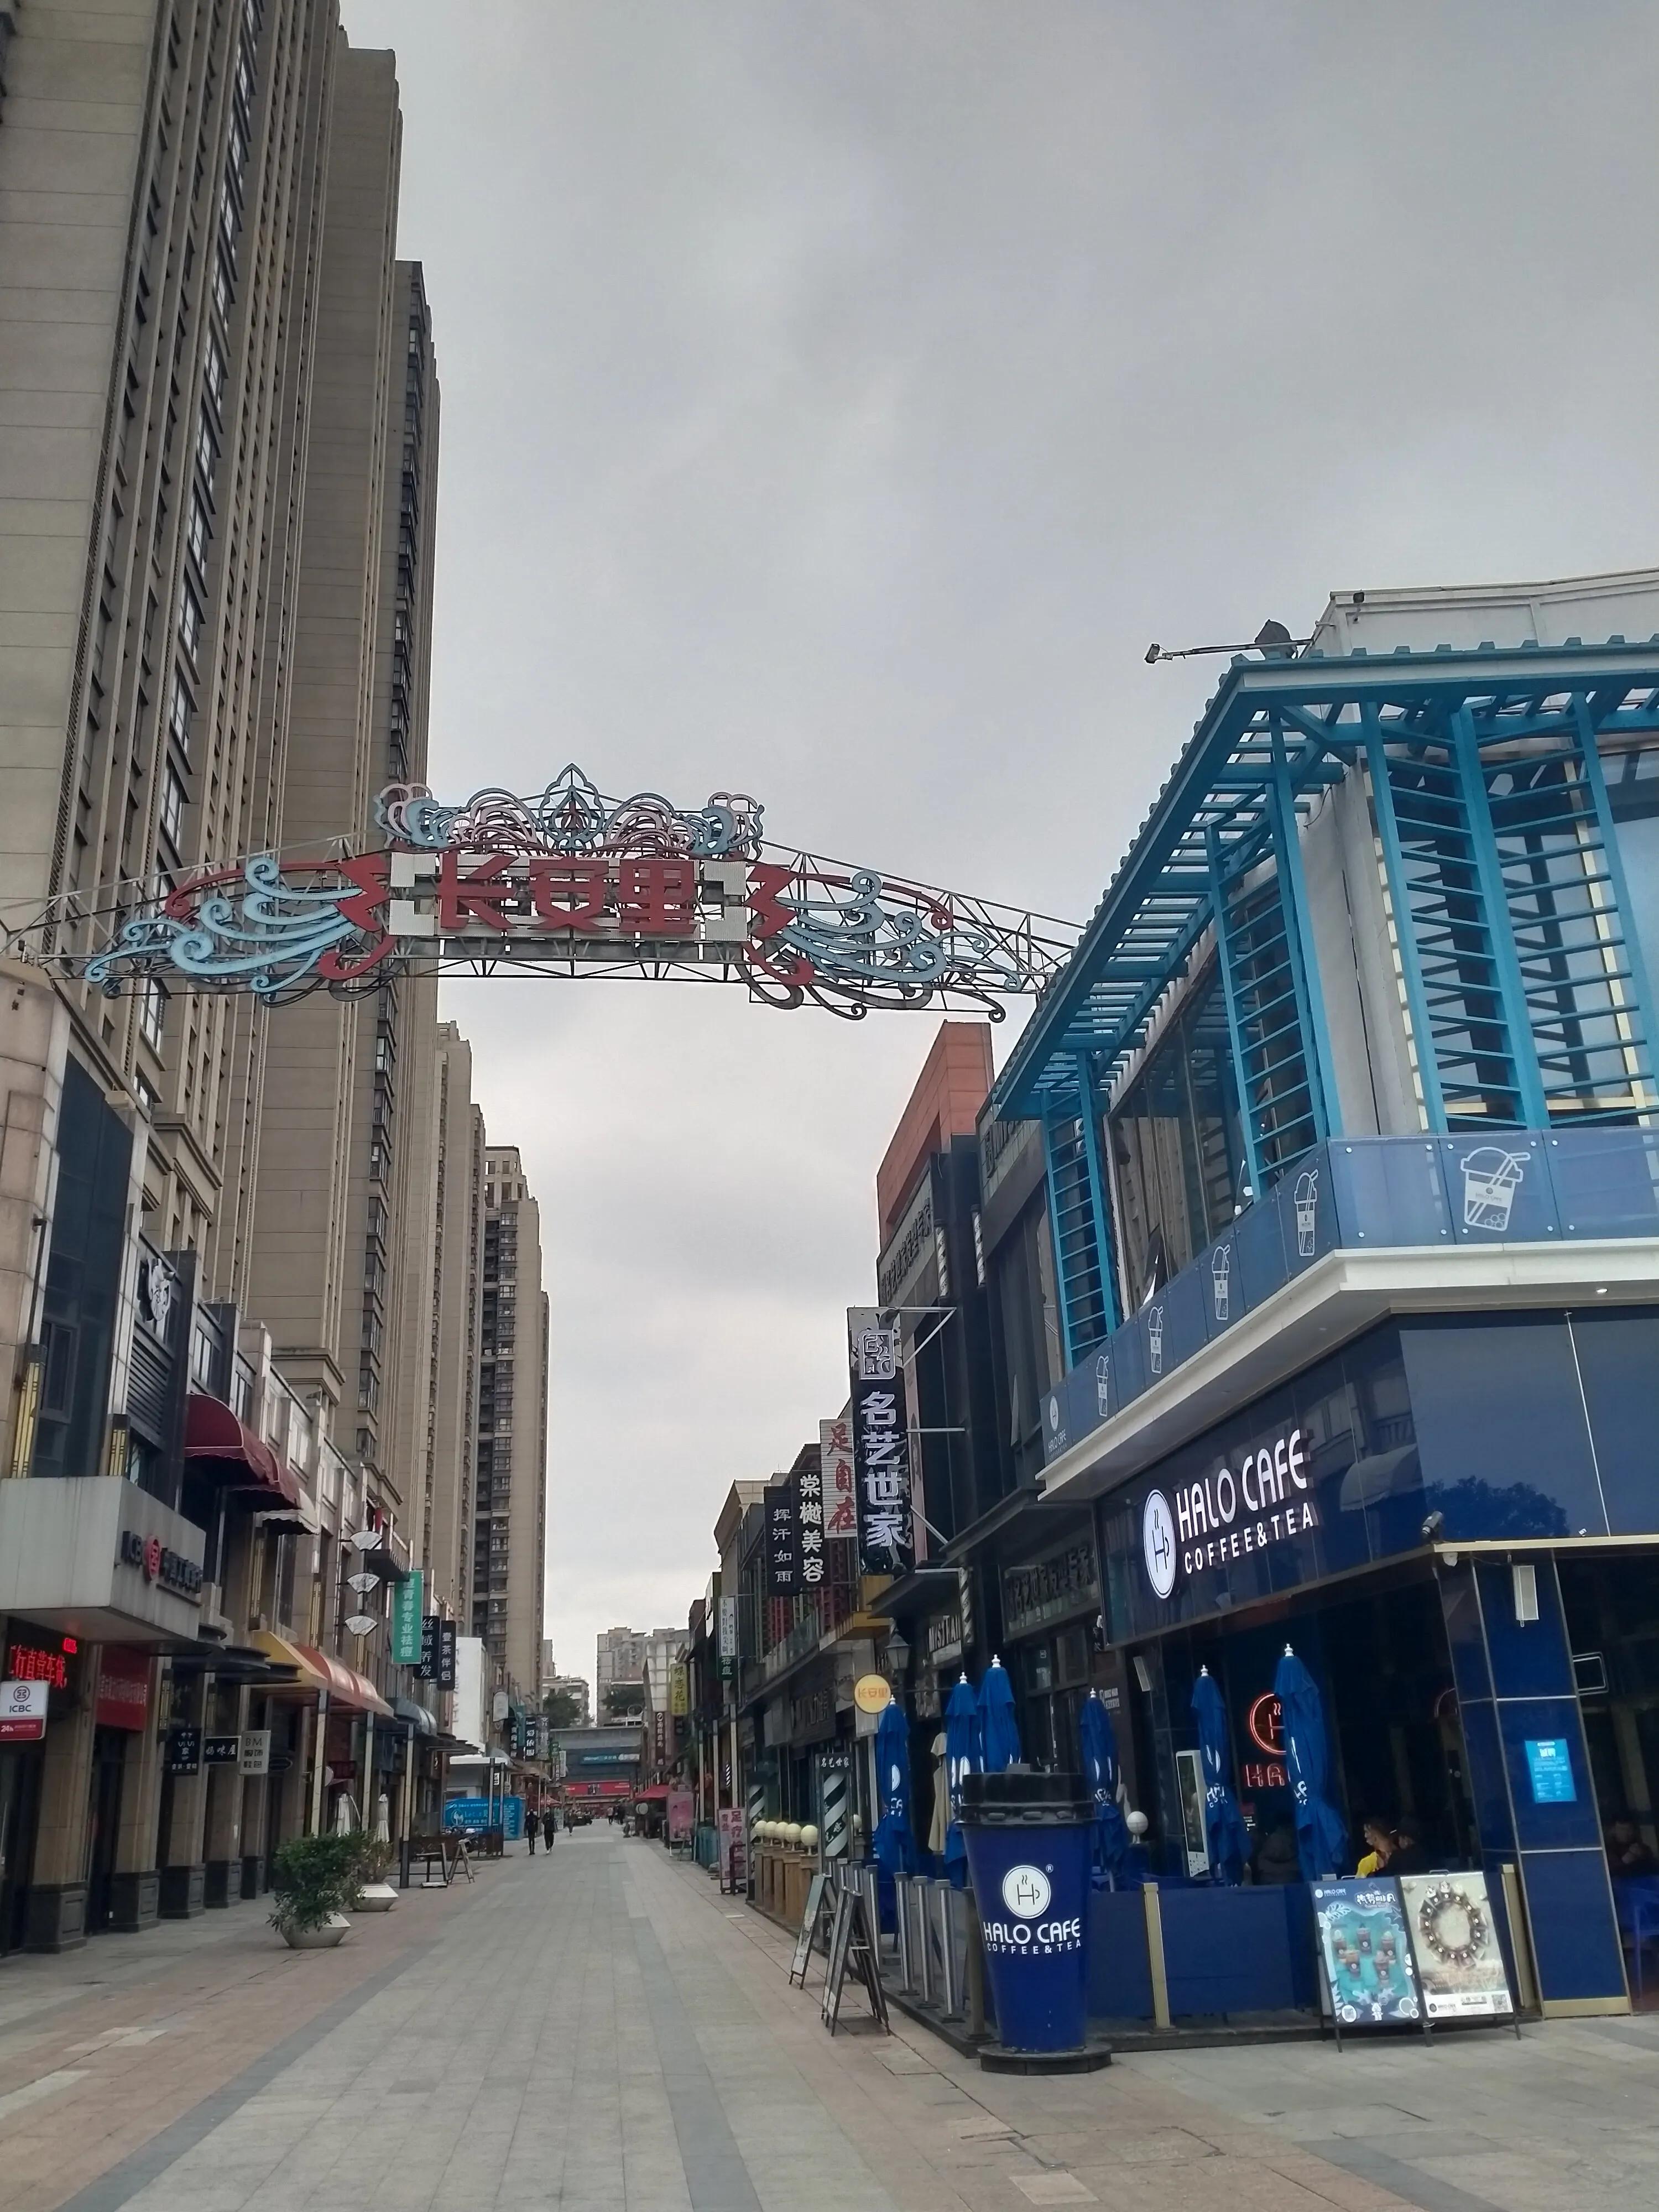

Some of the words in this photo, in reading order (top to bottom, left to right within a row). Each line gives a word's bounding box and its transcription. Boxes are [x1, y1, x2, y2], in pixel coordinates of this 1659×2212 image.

[436, 851, 698, 935] 长安里
[827, 1422, 857, 1533] 足自在
[860, 1391, 906, 1547] 名艺世家
[1176, 1468, 1237, 1542] HALO
[1242, 1428, 1308, 1512] CAFE
[772, 1508, 794, 1583] 挥汗如雨
[420, 1618, 434, 1676] 丝域养发
[441, 1632, 452, 1681] 壹茶伴侣
[9, 1705, 32, 1713] ICBC
[858, 1687, 888, 1699] 长安里
[246, 1738, 262, 1746] BM
[983, 1921, 1031, 1944] HALO
[1037, 1917, 1081, 1943] CAFE
